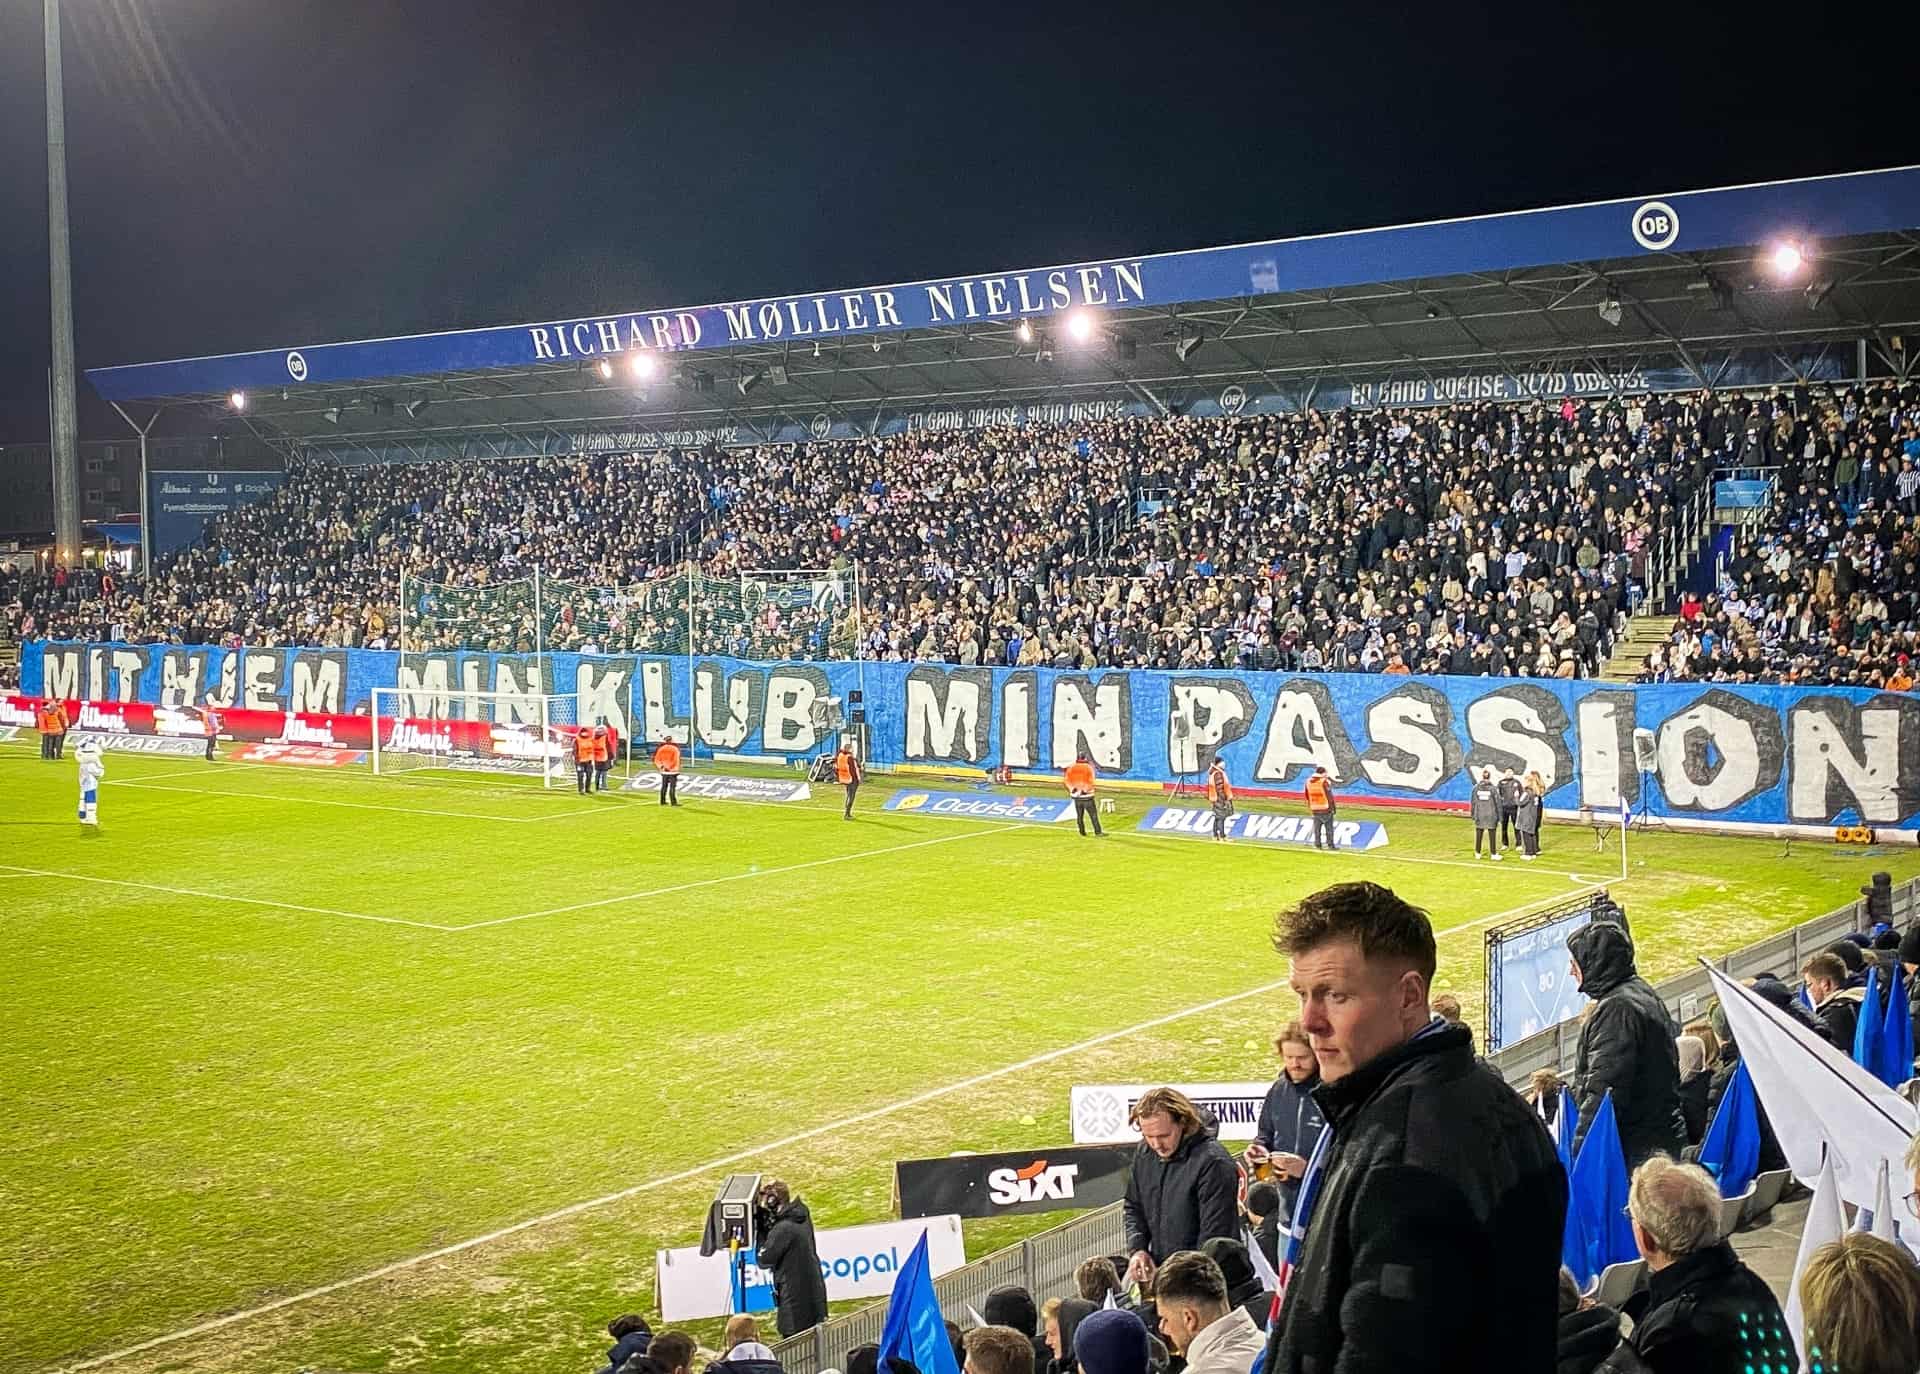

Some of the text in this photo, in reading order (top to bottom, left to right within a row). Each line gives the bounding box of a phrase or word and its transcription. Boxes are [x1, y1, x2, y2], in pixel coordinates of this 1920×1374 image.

[1641, 216, 1670, 236] OB
[529, 262, 1146, 360] RICHARD MØLLER NIELSEN
[1379, 380, 1427, 404] GANG
[43, 648, 143, 703] MIT
[397, 658, 544, 727] MIN
[905, 678, 1123, 770] MIN
[1169, 683, 1902, 824] PASSION
[932, 797, 1046, 818] Oddset
[1154, 808, 1360, 845] BLUE WATR
